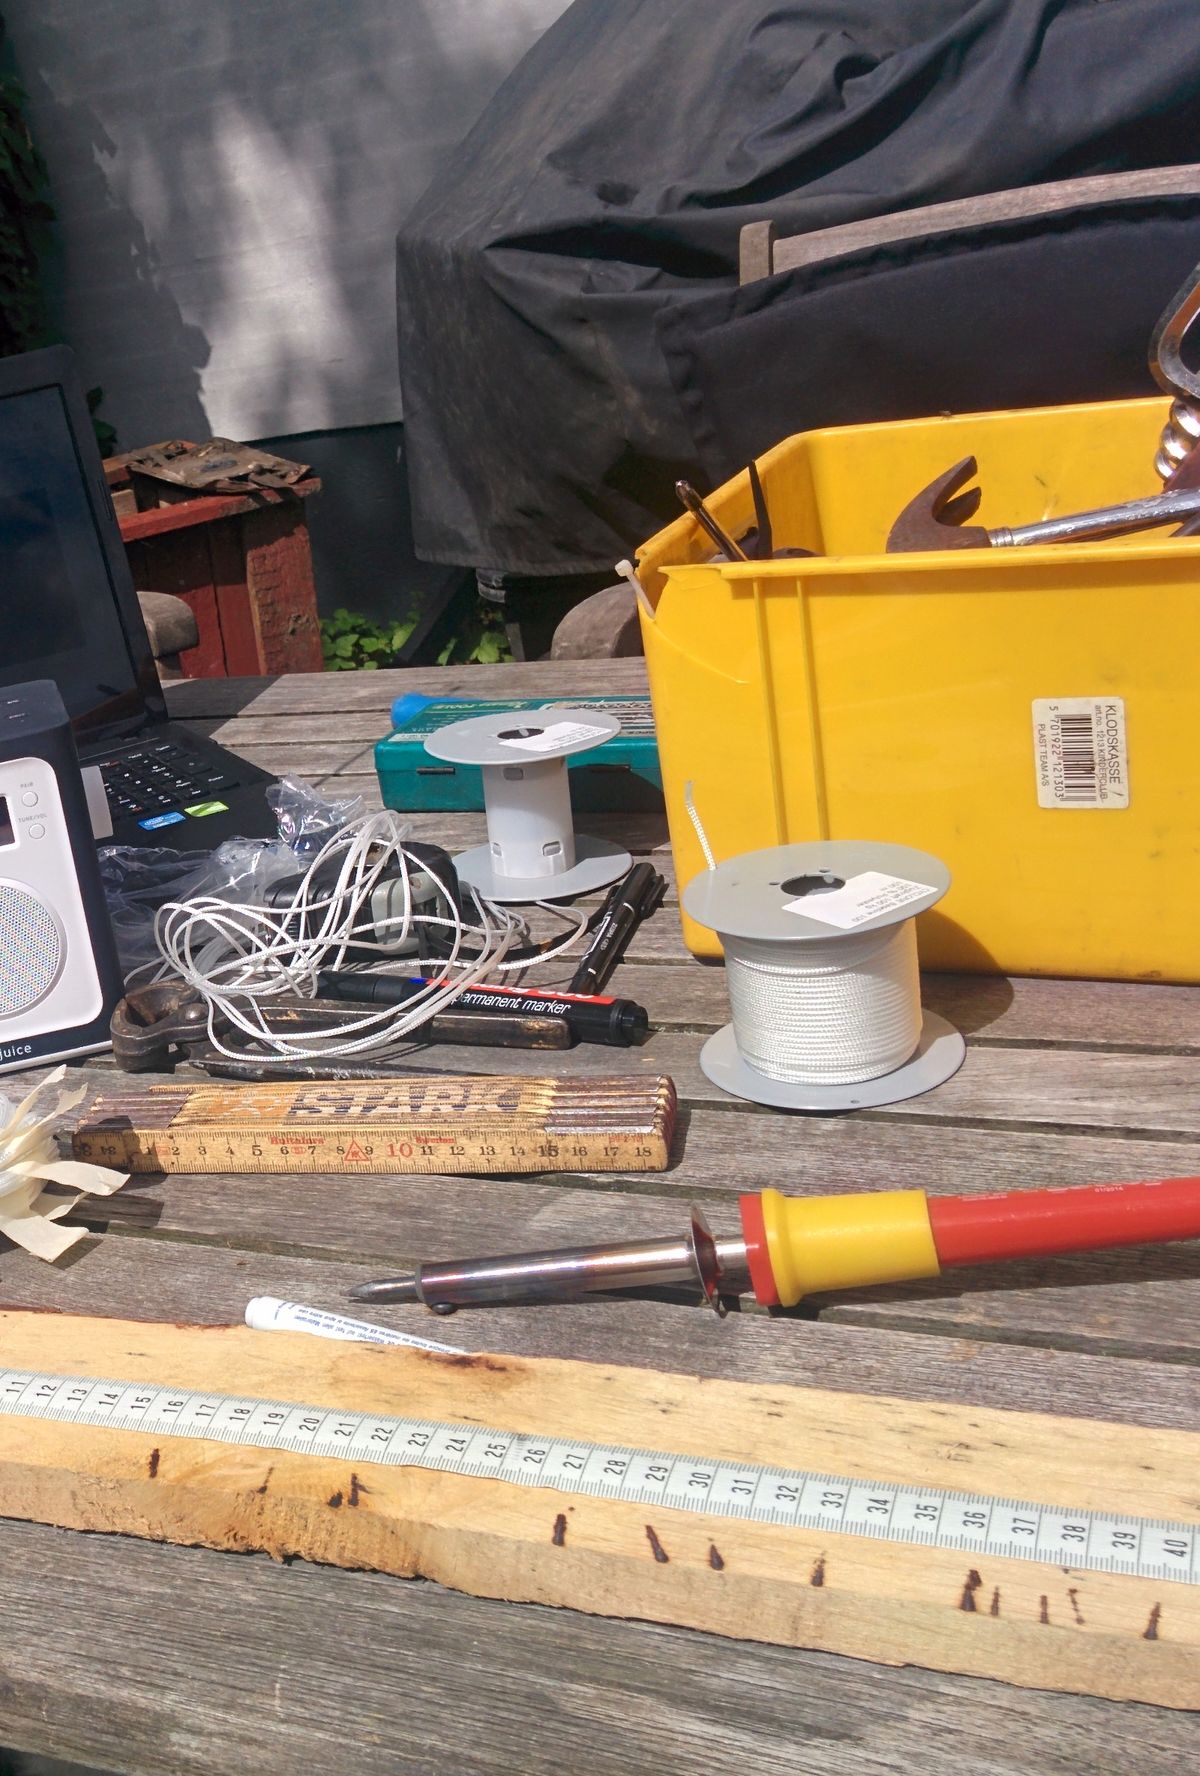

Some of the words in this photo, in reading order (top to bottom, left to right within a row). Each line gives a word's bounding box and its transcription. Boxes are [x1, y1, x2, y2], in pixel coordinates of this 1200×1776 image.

[1038, 723, 1047, 749] PLAST
[1051, 718, 1061, 756] 701922
[1105, 705, 1121, 784] KLODSKASSE
[1040, 750, 1048, 772] TEAM
[1098, 750, 1108, 800] KINDERCLUB
[1041, 774, 1050, 787] A/S
[1053, 762, 1064, 799] 121303
[521, 999, 572, 1015] marker
[172, 1147, 180, 1155] 2
[199, 1146, 207, 1155] 3
[225, 1146, 235, 1155] 4
[252, 1145, 263, 1156] 5
[280, 1146, 289, 1155] 6
[308, 1146, 317, 1155] 7
[336, 1146, 345, 1155] 8
[365, 1146, 374, 1155] 9
[387, 1143, 413, 1158] 10
[420, 1146, 434, 1156] 11
[450, 1146, 465, 1156] 12
[480, 1146, 496, 1156] 13
[510, 1146, 526, 1156] 14
[538, 1145, 558, 1157] 15
[572, 1146, 587, 1156] 16
[603, 1146, 619, 1157] 17
[635, 1146, 652, 1157] 18
[5, 1380, 27, 1393] 11
[36, 1384, 57, 1397] 12
[67, 1388, 88, 1401] 13
[98, 1392, 119, 1406] 14
[130, 1396, 152, 1410] 15
[162, 1400, 184, 1414] 16
[195, 1403, 216, 1417] 17
[228, 1407, 251, 1422] 18
[262, 1412, 285, 1427] 19
[298, 1417, 321, 1432] 20
[334, 1422, 356, 1437] 21
[370, 1427, 393, 1443] 22
[407, 1432, 430, 1448] 23
[445, 1437, 467, 1453] 24
[484, 1442, 506, 1459] 25
[523, 1448, 546, 1465] 26
[563, 1453, 586, 1470] 27
[603, 1459, 627, 1476] 28
[644, 1465, 669, 1482] 29
[688, 1472, 712, 1489] 30
[731, 1478, 755, 1495] 31
[775, 1485, 799, 1502] 32
[820, 1491, 844, 1509] 33
[866, 1497, 891, 1515] 34
[914, 1504, 939, 1521] 35
[962, 1511, 986, 1529] 36
[1011, 1518, 1037, 1536] 37
[1061, 1524, 1086, 1543] 38
[1111, 1531, 1137, 1550] 39
[1163, 1538, 1189, 1558] 40
